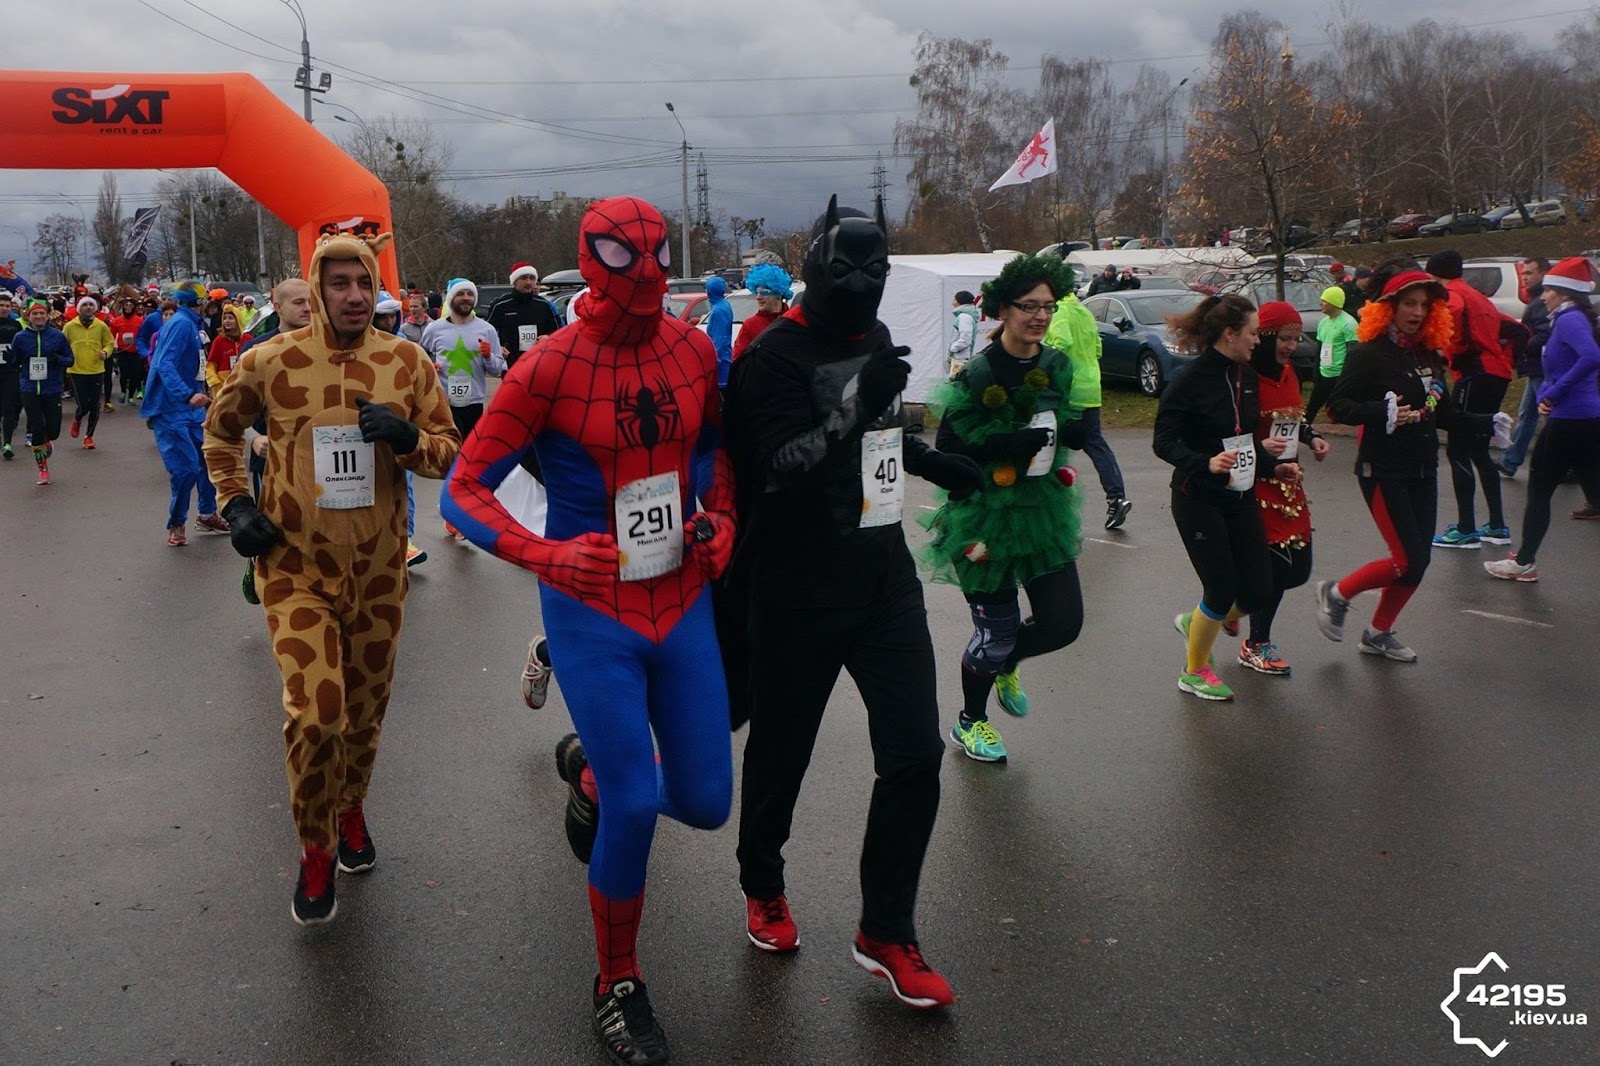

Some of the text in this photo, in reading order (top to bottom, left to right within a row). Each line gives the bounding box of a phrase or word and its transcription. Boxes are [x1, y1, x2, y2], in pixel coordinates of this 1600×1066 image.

[100, 127, 127, 135] rent
[521, 333, 536, 341] 300
[451, 385, 470, 395] 367
[1274, 422, 1297, 438] 767
[332, 450, 357, 474] 111
[875, 457, 897, 485] 40
[325, 475, 366, 483] Олександр
[628, 503, 673, 539] 291
